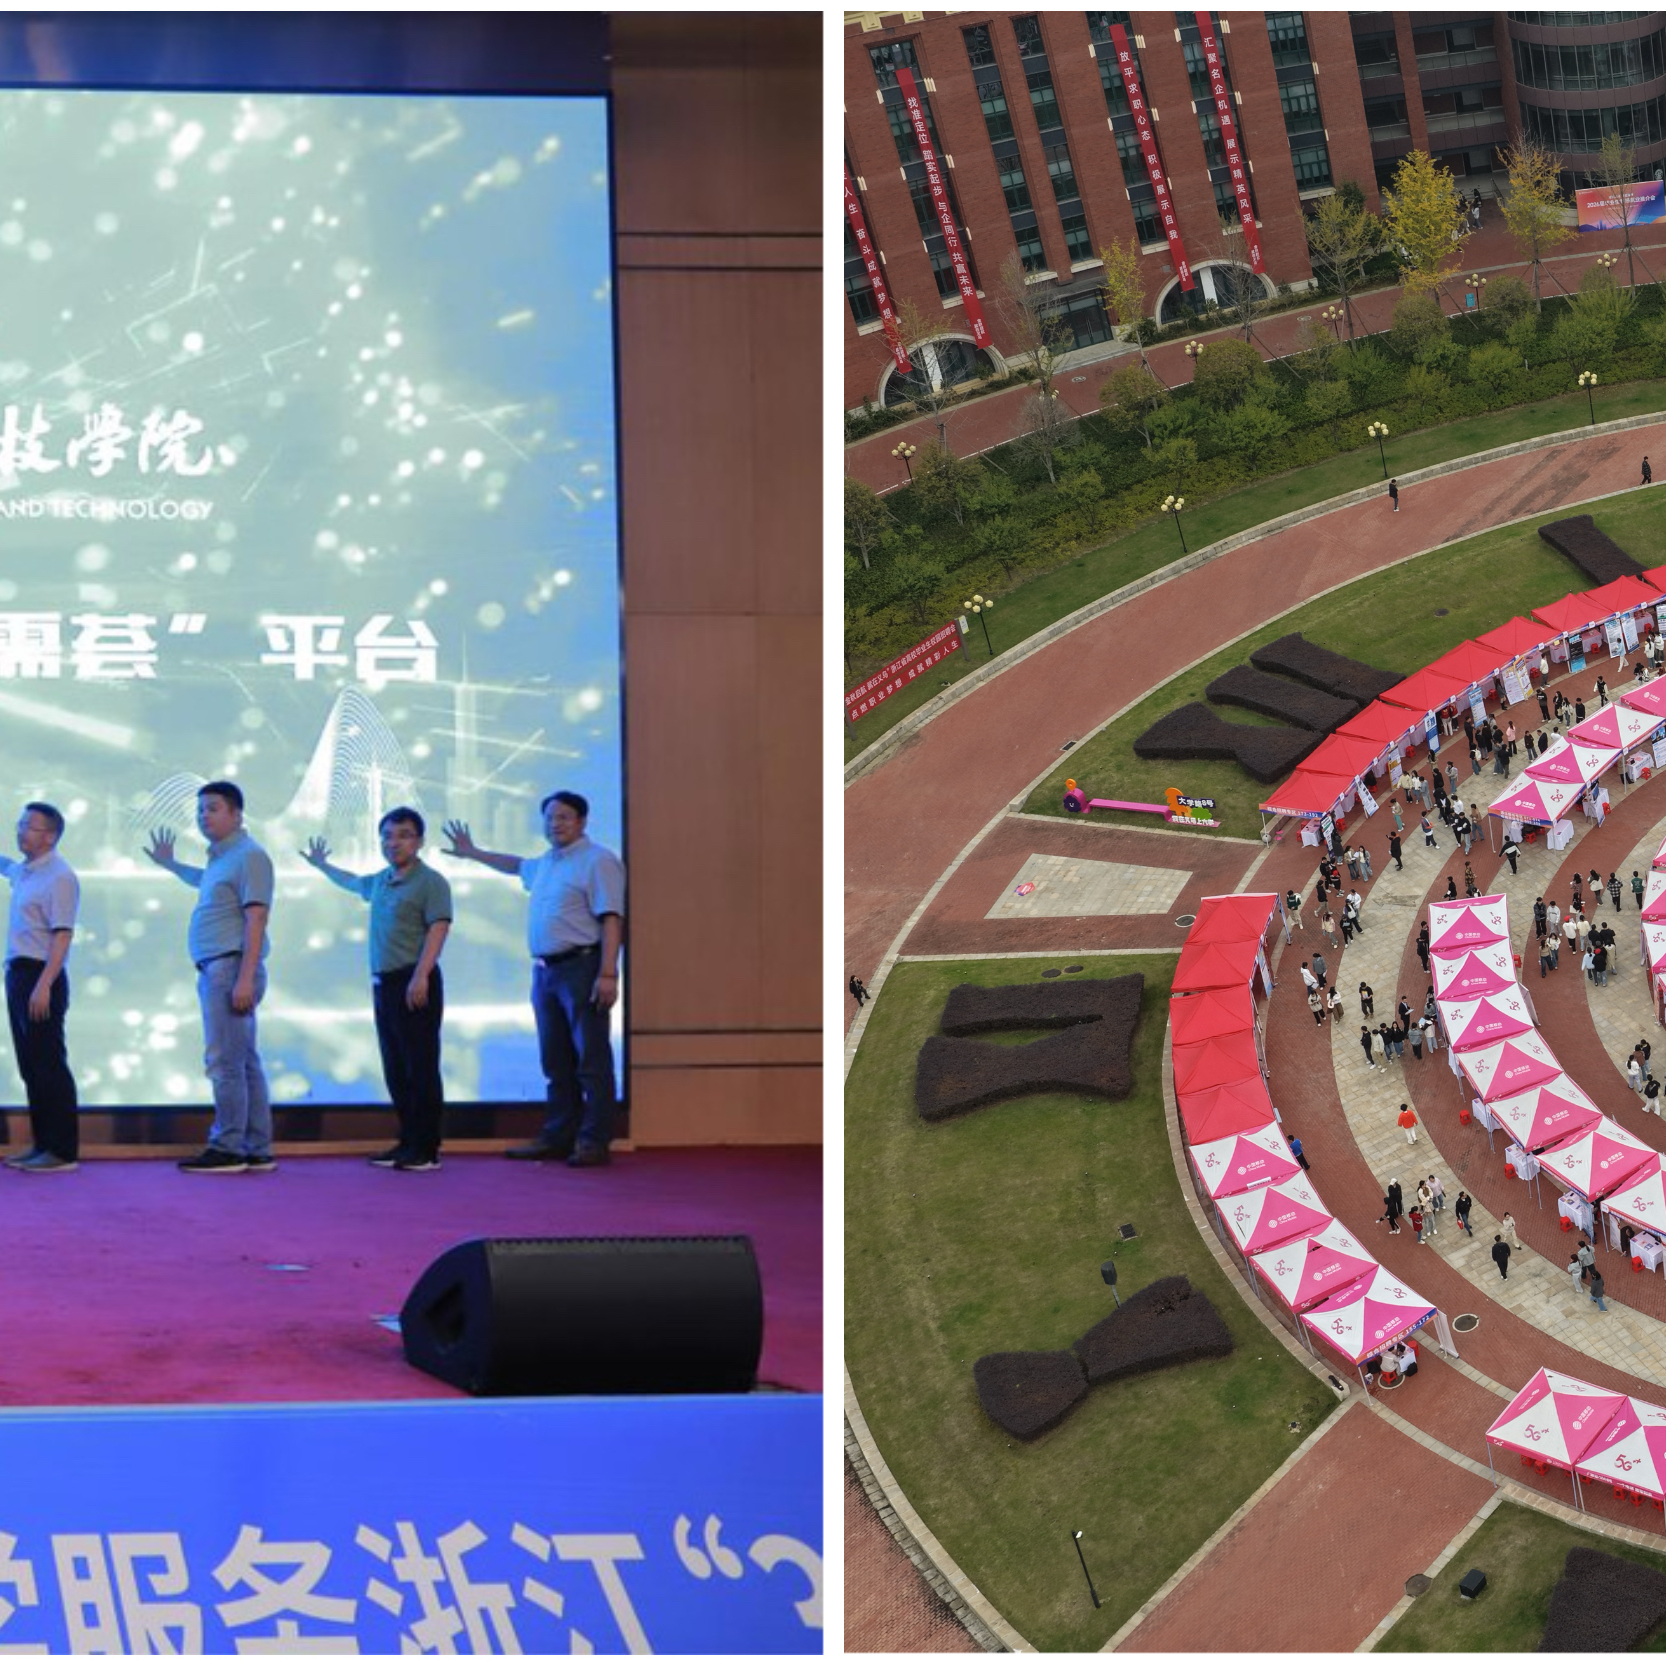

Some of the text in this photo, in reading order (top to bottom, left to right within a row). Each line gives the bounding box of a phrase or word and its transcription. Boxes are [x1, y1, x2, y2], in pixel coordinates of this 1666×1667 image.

[907, 96, 974, 298] 找准定位 踏实起步 与企同行 共赢未来
[1119, 50, 1179, 240] 放平求职心态 积极展示自我
[1203, 36, 1253, 224] 汇聚名企机遇 展示精英风采
[50, 497, 214, 520] TECHNOLOGY
